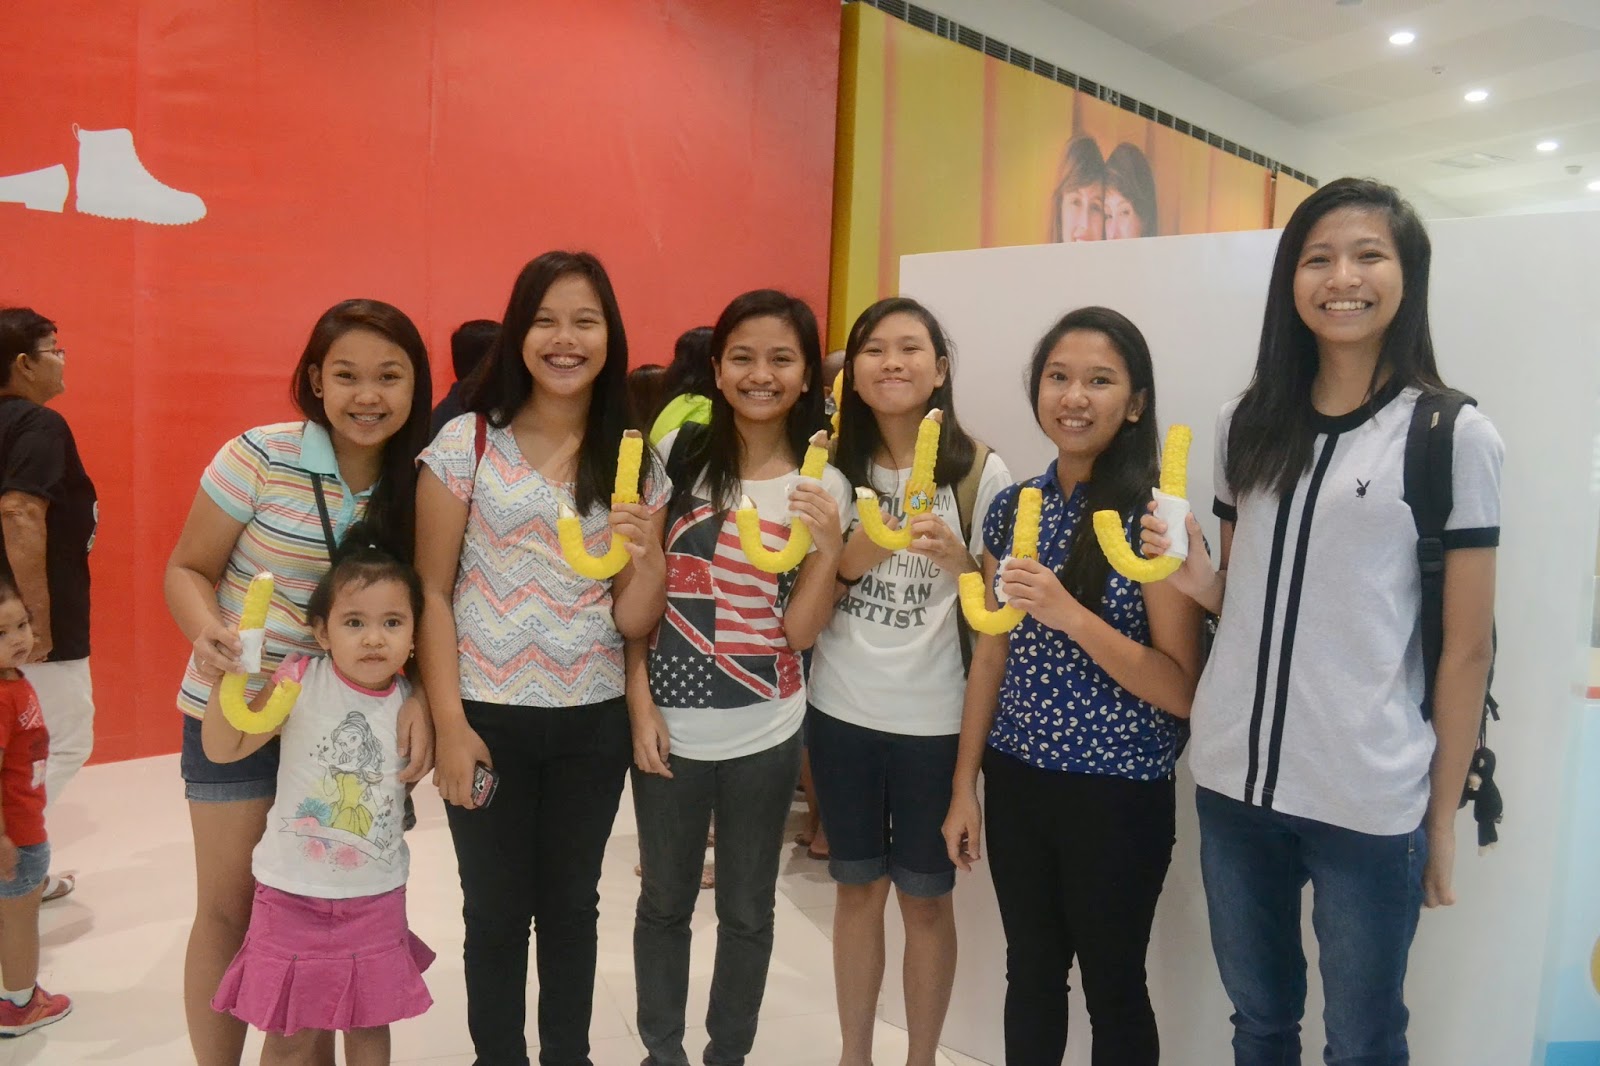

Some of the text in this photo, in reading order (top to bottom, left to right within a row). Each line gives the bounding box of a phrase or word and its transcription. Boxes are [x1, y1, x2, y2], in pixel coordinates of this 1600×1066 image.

[879, 494, 951, 523] OU AN
[860, 575, 932, 605] ARE AN
[838, 595, 927, 629] ARTIST
